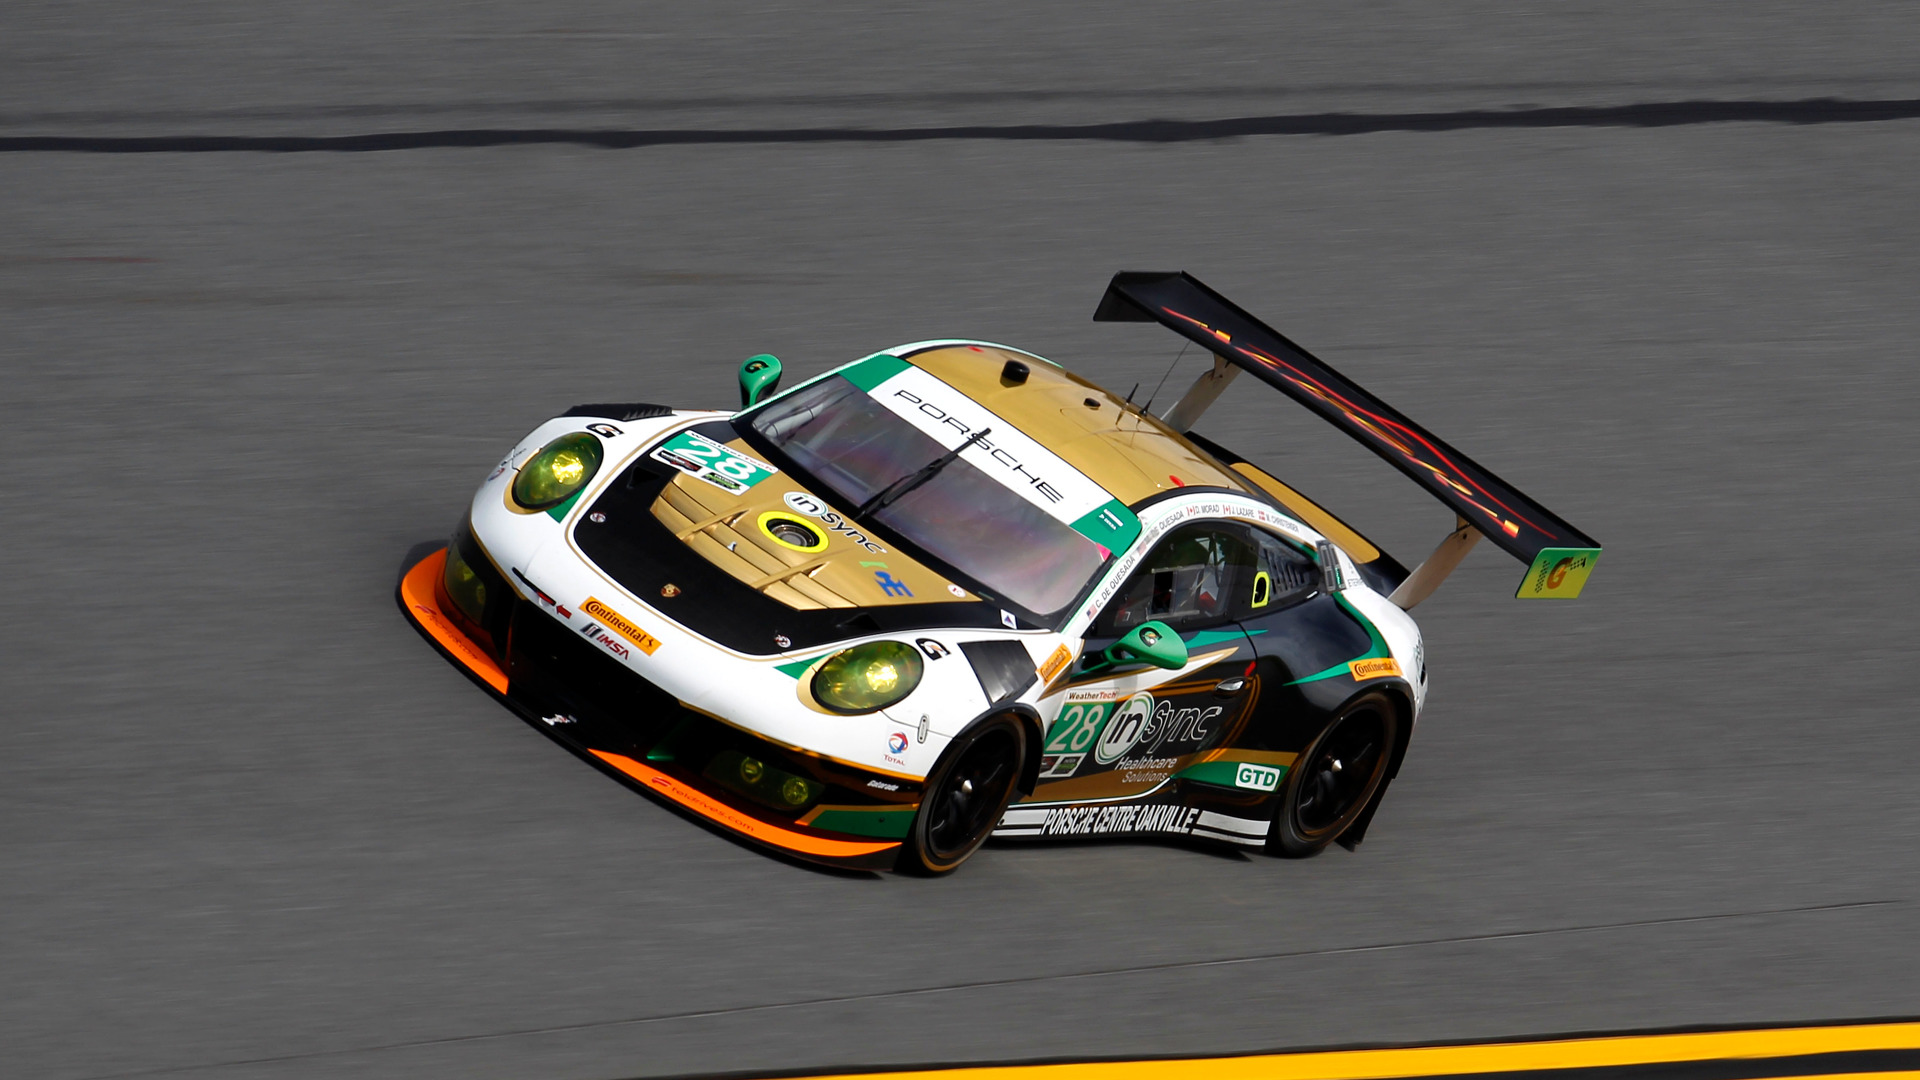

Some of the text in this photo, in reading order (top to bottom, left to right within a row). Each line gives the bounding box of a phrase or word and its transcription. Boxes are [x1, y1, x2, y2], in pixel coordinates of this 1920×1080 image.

[673, 440, 757, 480] 28
[894, 389, 1064, 503] PORSCHE
[1158, 510, 1185, 530] QUESADA
[1101, 587, 1111, 601] DE
[1110, 555, 1135, 588] QUESADA
[585, 601, 647, 642] Continental
[596, 634, 630, 660] IMSA
[1069, 691, 1117, 700] WeatherTech
[1046, 705, 1104, 751] 28
[1115, 756, 1177, 770] Healthcare
[1122, 771, 1168, 783] Solutions
[1239, 768, 1276, 786] GTD
[1041, 805, 1200, 835] PORSCHE CENTRE OAKVILLE
